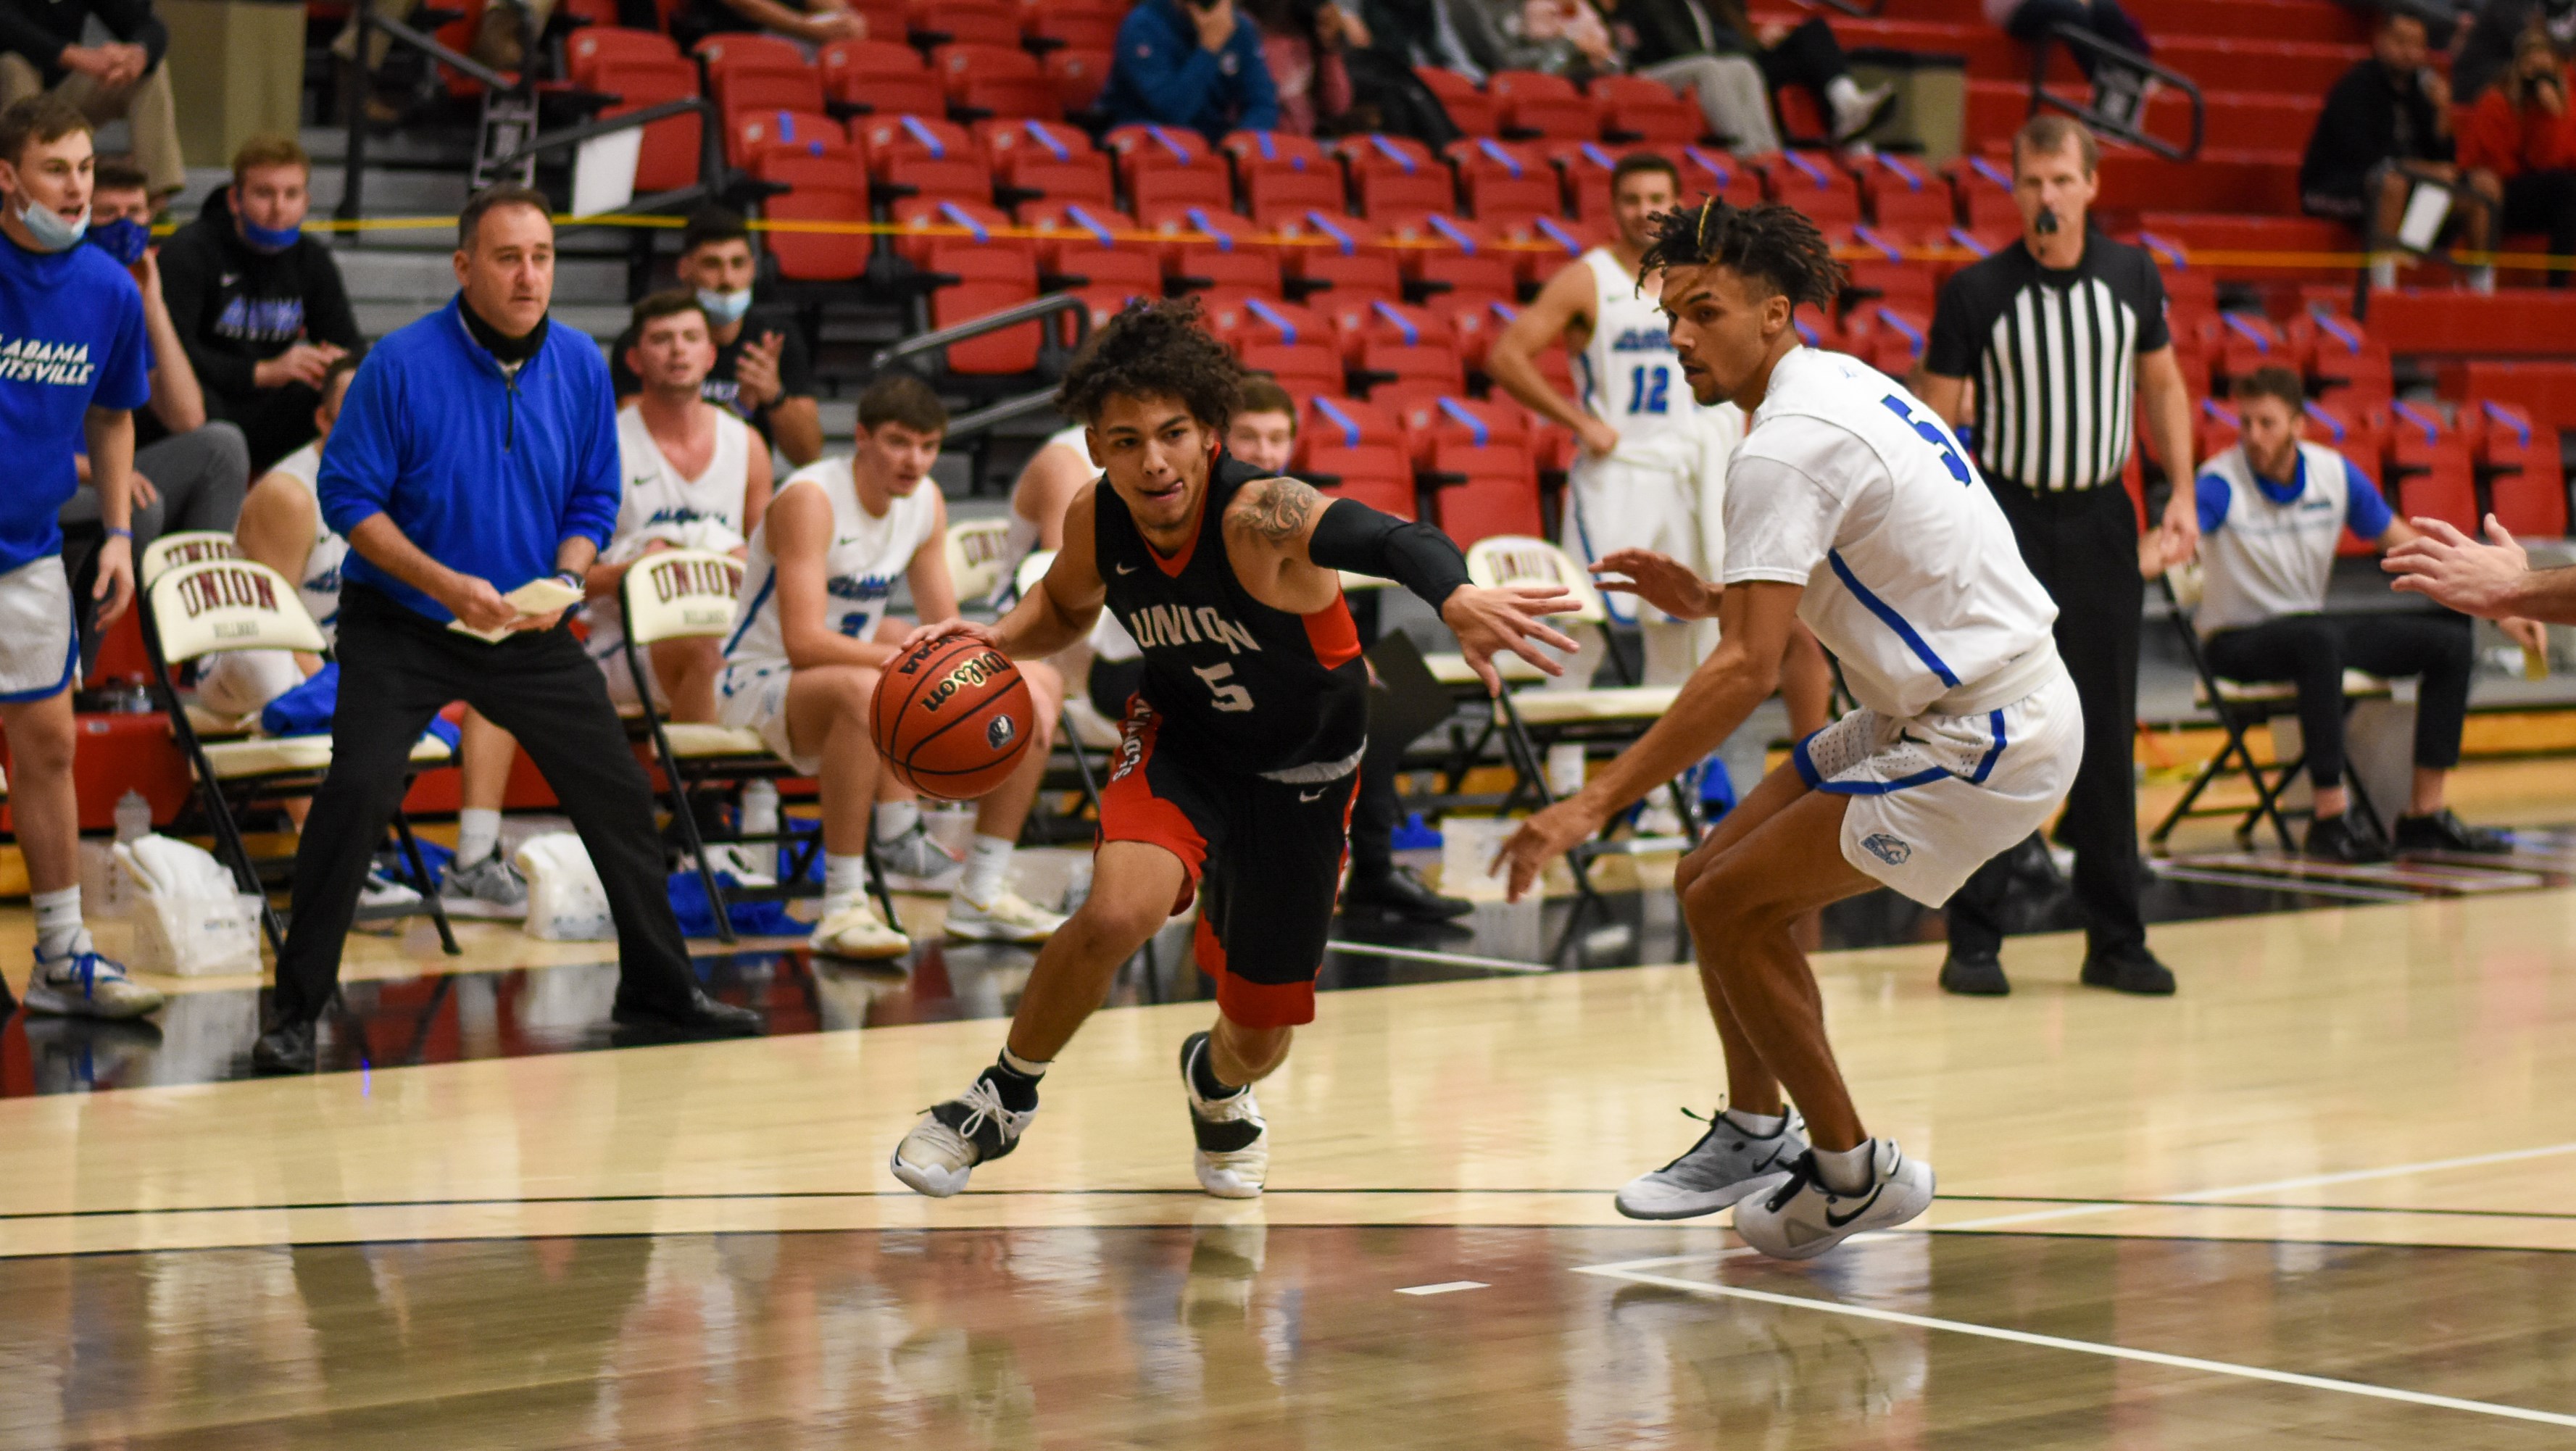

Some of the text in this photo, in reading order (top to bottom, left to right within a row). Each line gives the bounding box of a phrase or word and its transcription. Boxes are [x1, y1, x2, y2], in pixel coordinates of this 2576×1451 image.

[1628, 364, 1669, 415] 12
[1880, 394, 1972, 488] 5
[178, 567, 279, 618] UNION
[650, 560, 744, 604] UNION
[1129, 603, 1263, 654] UNION
[921, 650, 1012, 713] Wilson
[1192, 661, 1255, 712] 5
